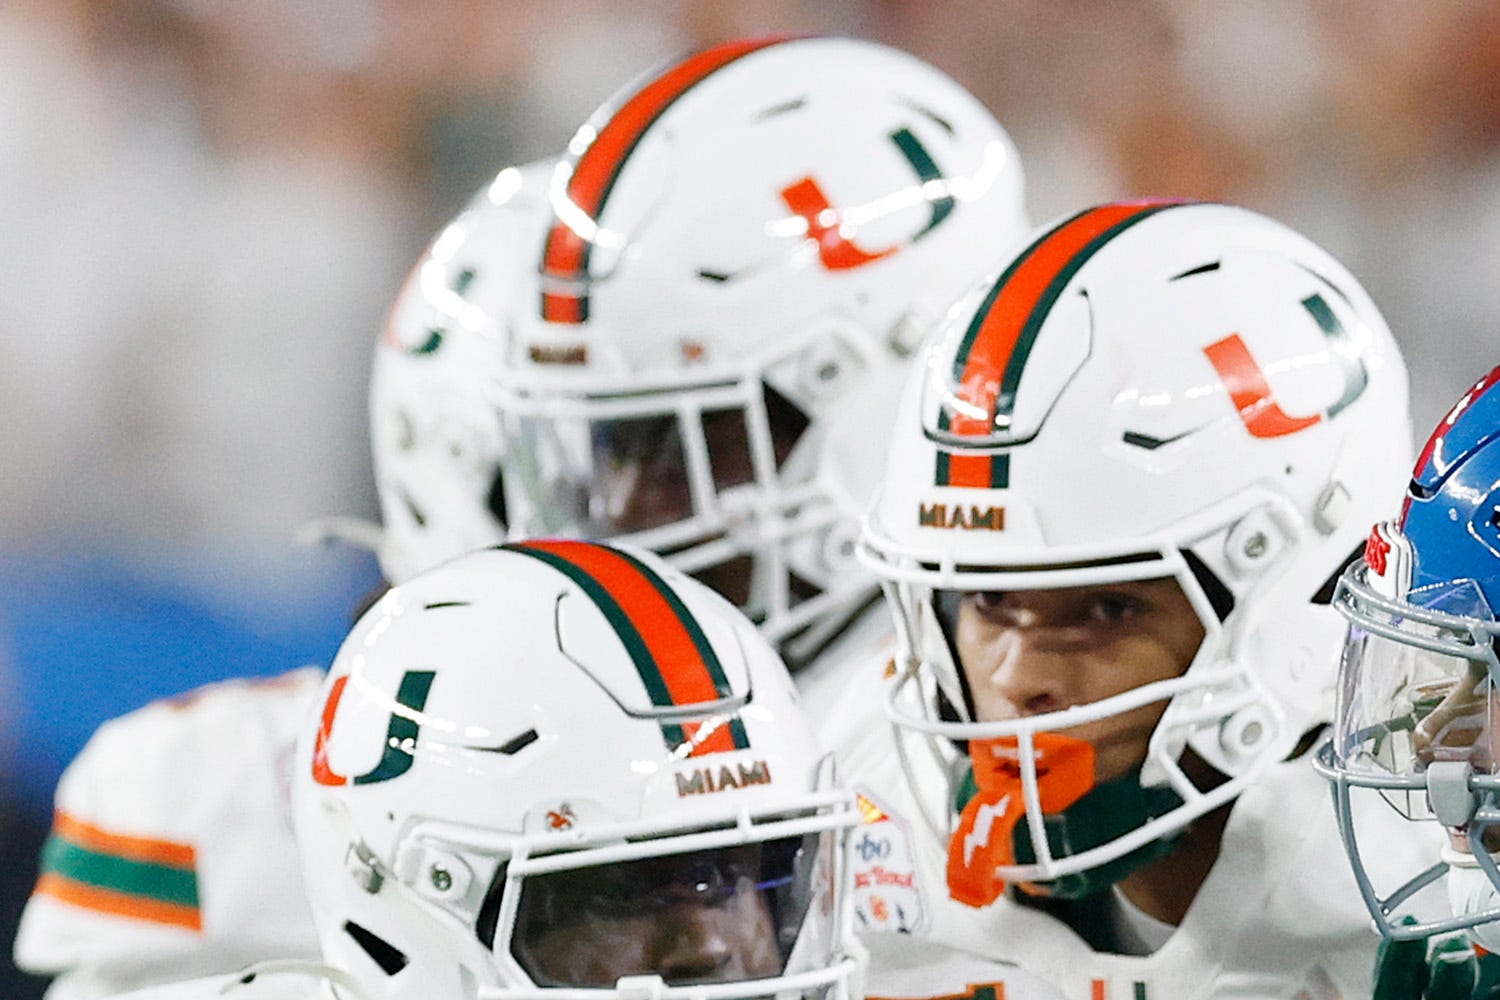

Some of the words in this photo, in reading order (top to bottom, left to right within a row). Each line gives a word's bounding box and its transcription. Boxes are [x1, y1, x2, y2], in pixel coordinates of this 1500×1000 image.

[781, 128, 955, 271] U
[1202, 293, 1368, 438] U
[919, 502, 1005, 532] MIAMI
[312, 670, 437, 786] U
[675, 760, 771, 798] MIAMI
